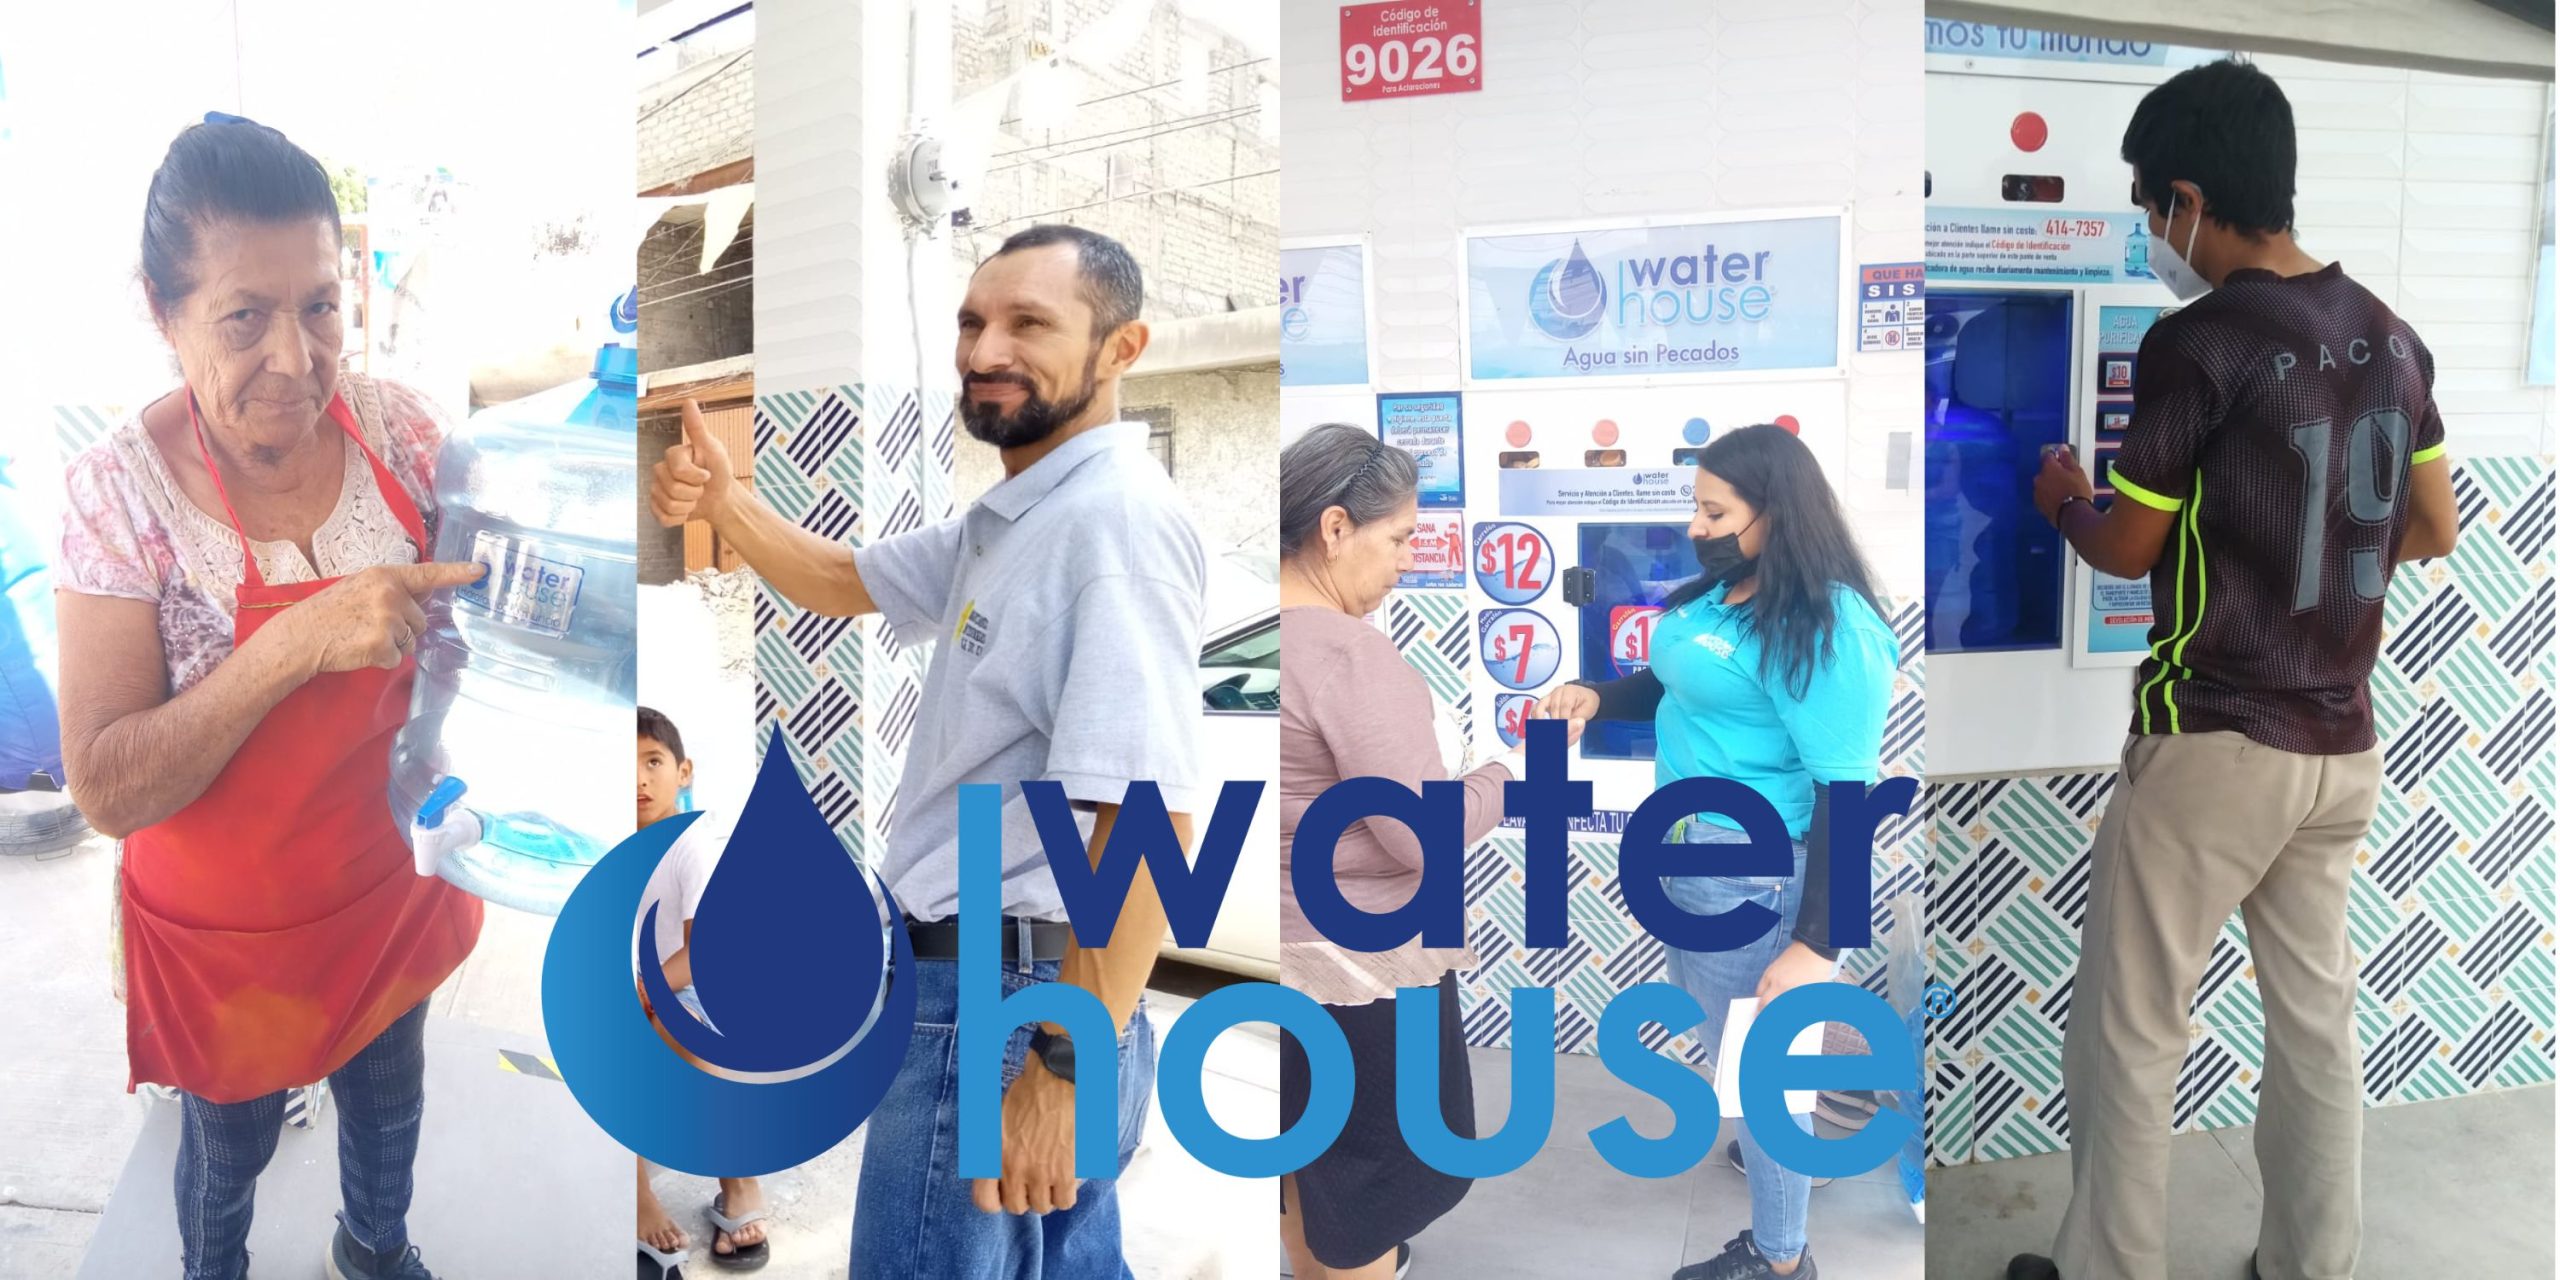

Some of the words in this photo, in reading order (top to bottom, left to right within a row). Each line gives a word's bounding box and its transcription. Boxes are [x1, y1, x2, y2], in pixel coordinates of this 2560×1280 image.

[1380, 8, 1421, 22] Código
[1424, 6, 1439, 18] de
[1373, 18, 1447, 37] identificación
[1345, 33, 1477, 86] 9026
[1382, 85, 1397, 94] Para
[1943, 224, 1948, 232] a
[1949, 222, 1979, 233] Clientes
[1980, 223, 2001, 234] llame
[2003, 224, 2014, 235] sin
[2045, 219, 2105, 237] 414-7357
[1991, 239, 2014, 251] Código
[2016, 241, 2024, 250] de
[2026, 240, 2071, 251] Identificación
[1629, 244, 1770, 287] water
[1949, 264, 1957, 273] de
[1959, 266, 1975, 275] agua
[1976, 265, 1996, 274] recibe
[1997, 265, 2033, 274] diariamente
[2034, 266, 2079, 275] mantenimiento
[1872, 269, 1901, 281] QUE
[1618, 260, 1772, 325] house
[2112, 313, 2138, 329] AGUA
[2099, 330, 2145, 346] PURIFICA
[1563, 346, 1616, 370] Agua
[1623, 345, 1648, 365] sin
[1656, 340, 1739, 363] Pecados
[2273, 334, 2409, 382] PACO
[1645, 471, 1669, 480] water
[1558, 490, 1579, 498] Servicio
[1585, 489, 1607, 497] Atención
[1635, 489, 1651, 497] llame
[1602, 498, 1619, 506] Código
[2289, 406, 2413, 617] 19
[1417, 523, 1437, 534] SANA
[1481, 532, 1542, 590] $12
[1494, 624, 1534, 684] $7
[1610, 812, 1623, 833] TU
